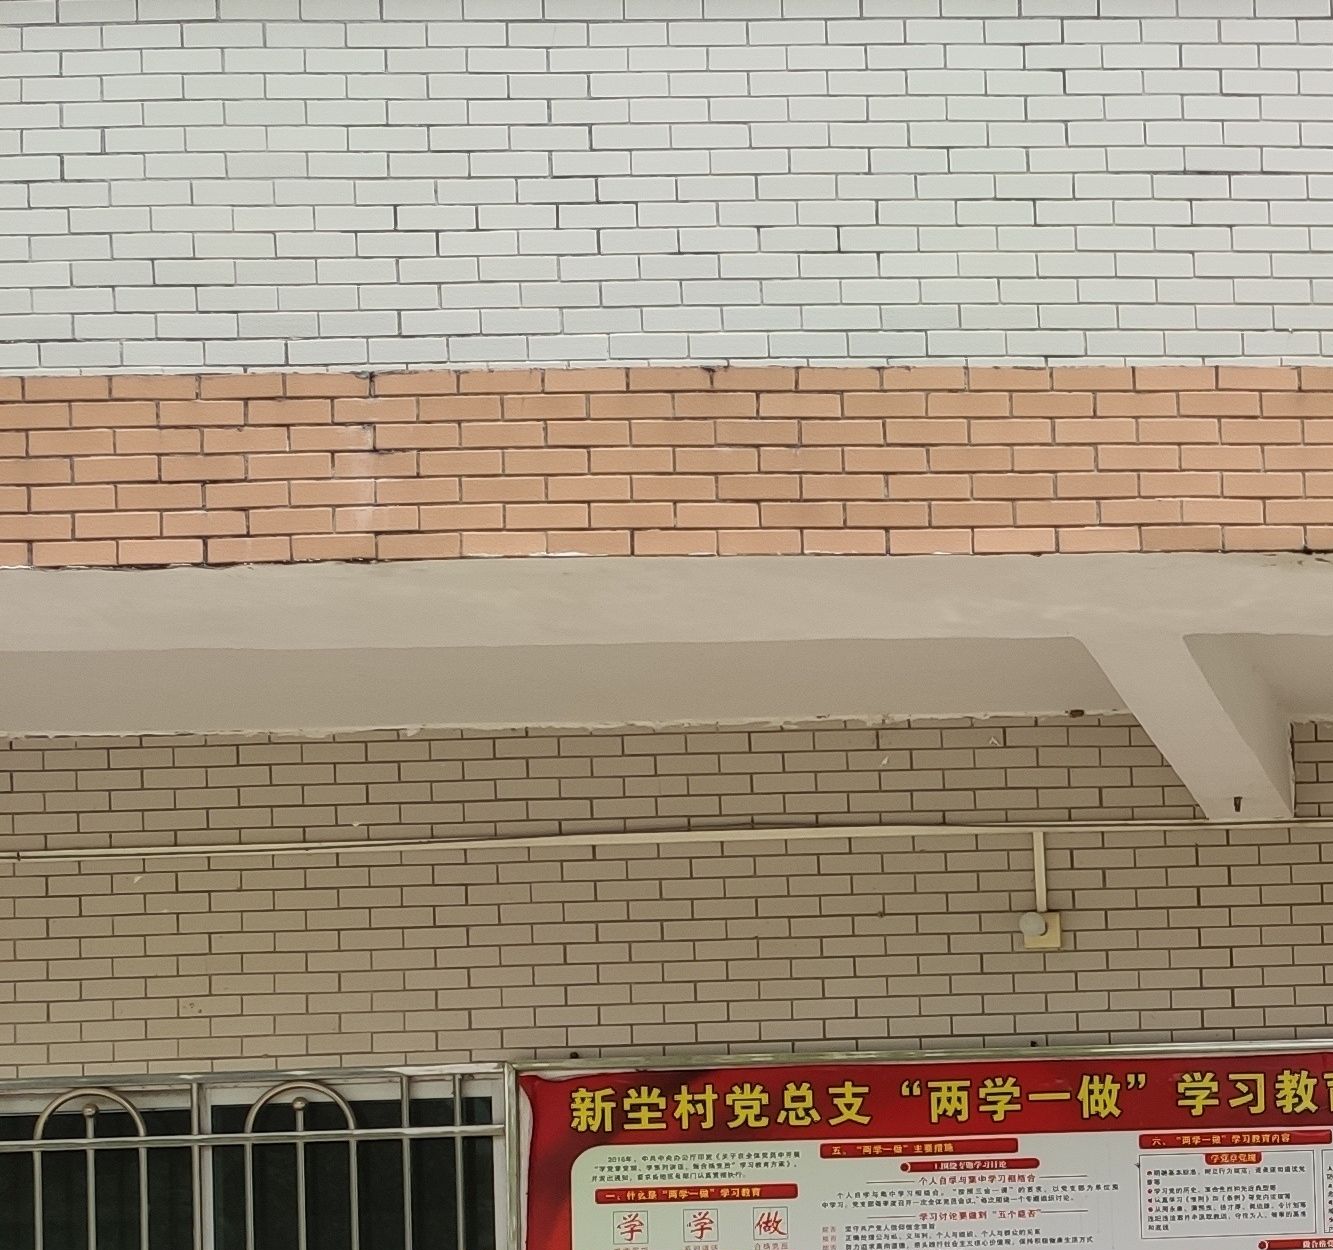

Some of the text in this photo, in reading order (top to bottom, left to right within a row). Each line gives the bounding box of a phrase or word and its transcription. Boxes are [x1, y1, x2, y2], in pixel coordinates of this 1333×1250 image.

[616, 1212, 644, 1242] 学
[686, 1210, 715, 1240] 学
[754, 1210, 787, 1236] 做
